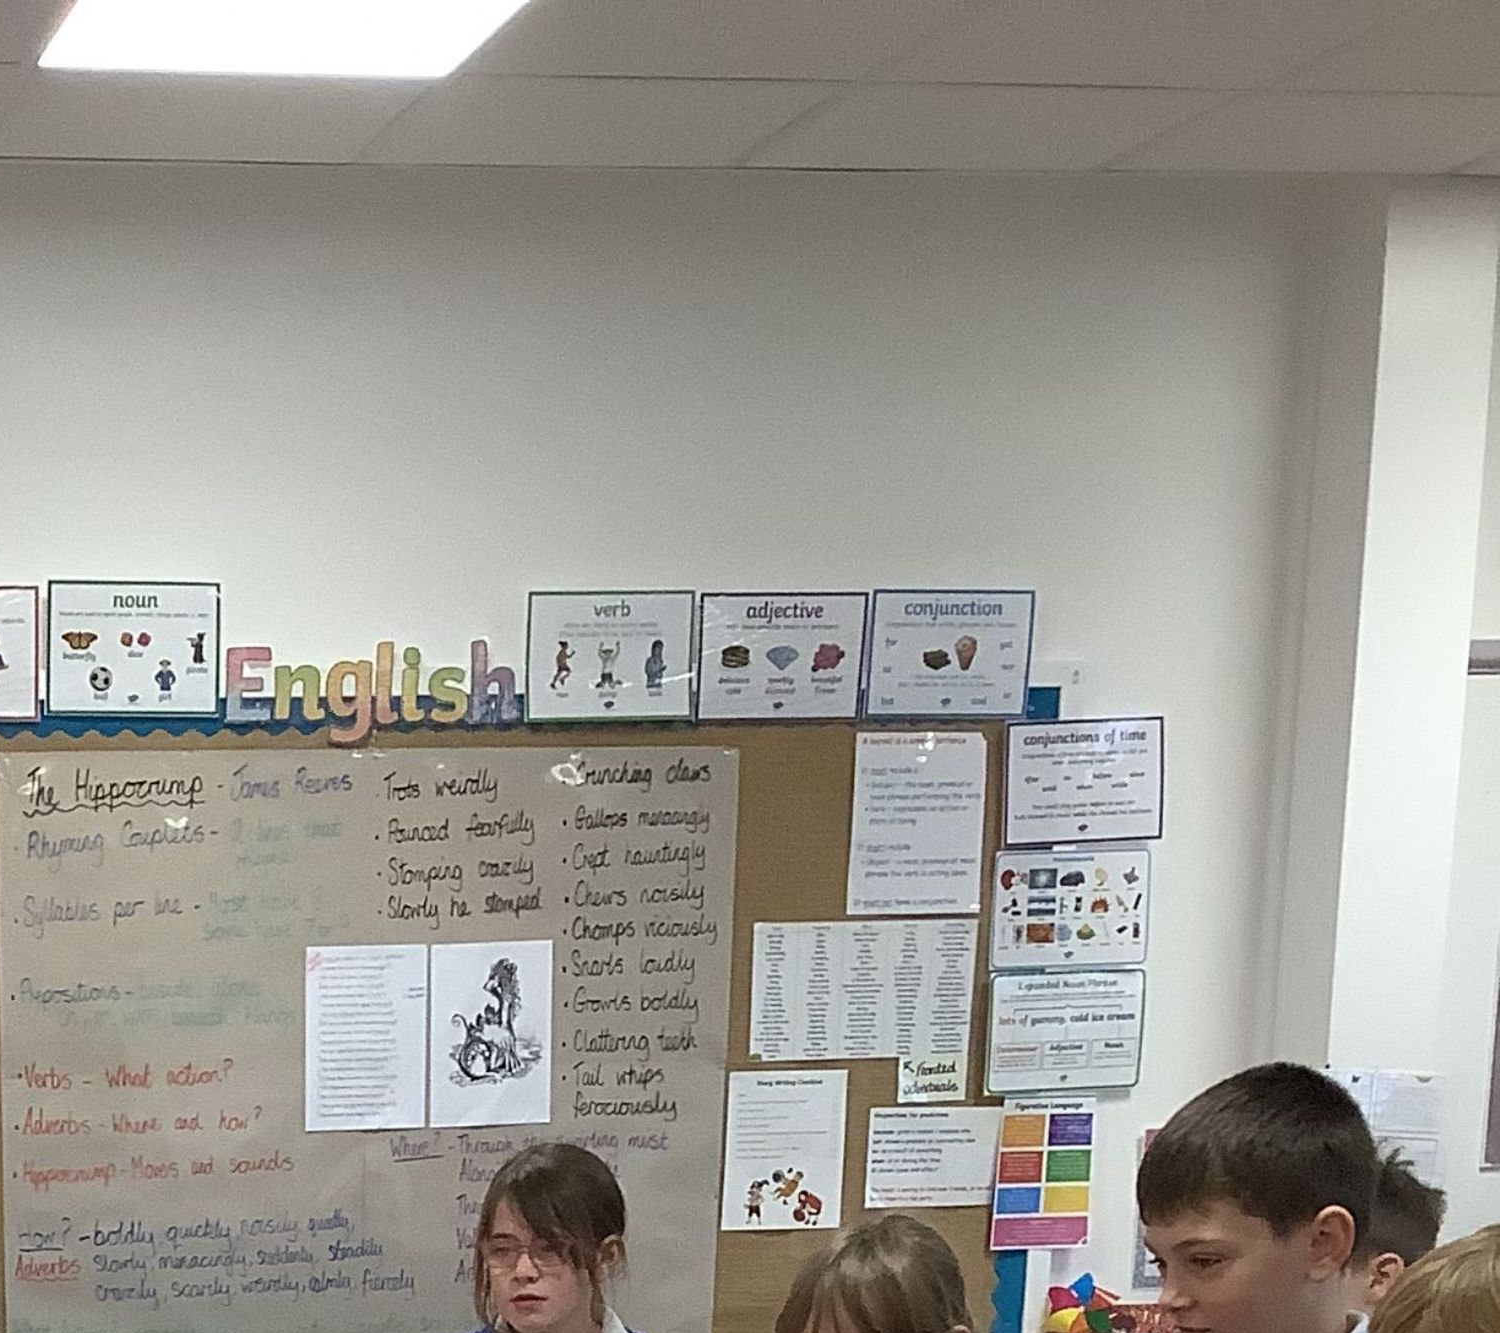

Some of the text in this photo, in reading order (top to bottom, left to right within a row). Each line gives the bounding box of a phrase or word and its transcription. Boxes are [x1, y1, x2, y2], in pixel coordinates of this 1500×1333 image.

[112, 593, 159, 609] noun
[593, 600, 632, 618] verb
[746, 602, 824, 625] adjective
[904, 600, 1003, 622] conjunction
[225, 638, 523, 747] English
[1023, 728, 1148, 749] conjunctions of time
[26, 765, 56, 807] The
[74, 766, 204, 813] Hippocrump
[435, 767, 498, 804] weirdly
[576, 760, 653, 793] Crunching
[574, 804, 628, 831] Gallops
[387, 856, 463, 893] Stomping
[572, 839, 706, 877] Crept hauntingly
[387, 894, 441, 931] Slowly
[450, 895, 472, 917] he
[571, 913, 718, 946] Chomps viciously
[571, 946, 696, 985] Snarls loudly
[573, 985, 699, 1024] Growls boldly
[573, 1028, 650, 1062] Clattering
[23, 1062, 73, 1090] Verbs
[104, 1062, 153, 1089] What
[573, 1060, 665, 1091] Tail whips
[22, 1106, 92, 1136] Adverbs
[111, 1112, 161, 1133] Where
[573, 1090, 678, 1123] ferociously
[229, 1150, 294, 1174] sounds
[15, 1254, 82, 1279] Adverbs
